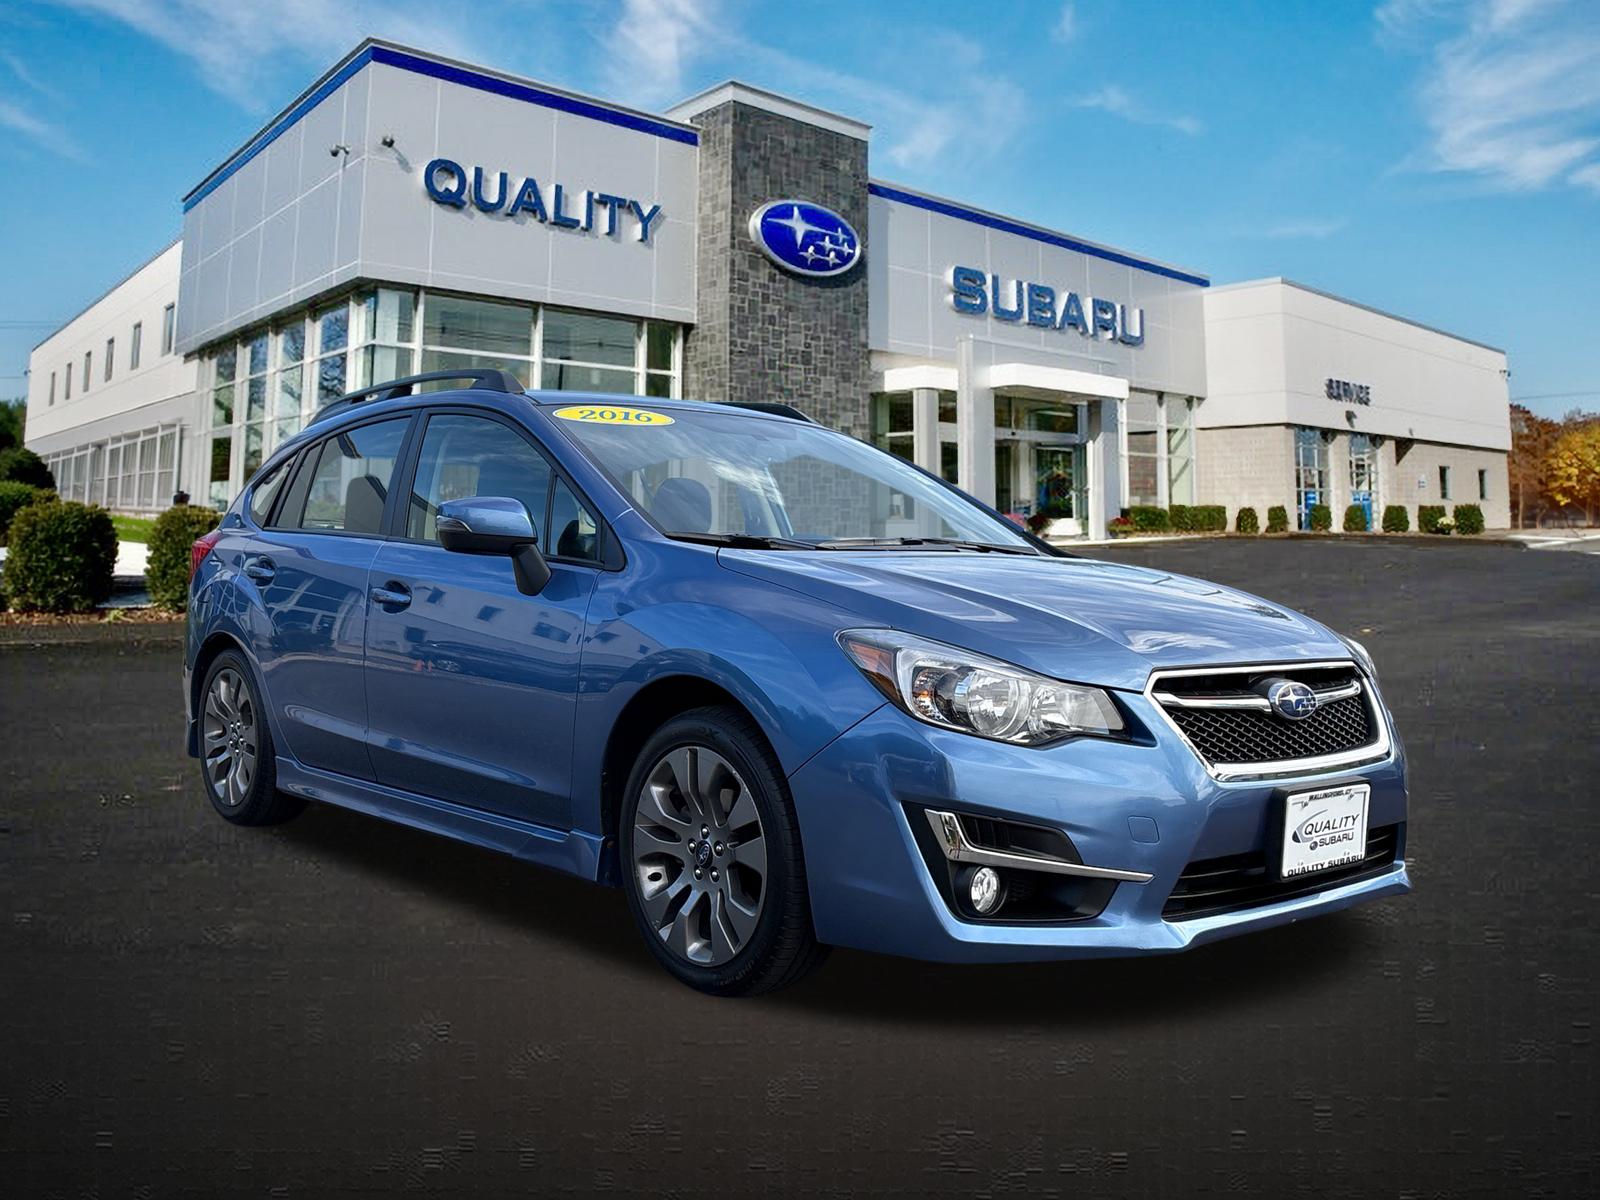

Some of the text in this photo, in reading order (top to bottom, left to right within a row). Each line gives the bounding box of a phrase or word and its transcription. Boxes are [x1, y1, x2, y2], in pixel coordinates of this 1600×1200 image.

[424, 158, 661, 242] QUALITY
[950, 265, 1144, 347] SUBARU
[578, 409, 652, 422] 2016
[1304, 813, 1360, 836] QUALITY
[1319, 831, 1354, 847] SUBARU
[1287, 853, 1363, 877] QUALITY SUBARU
